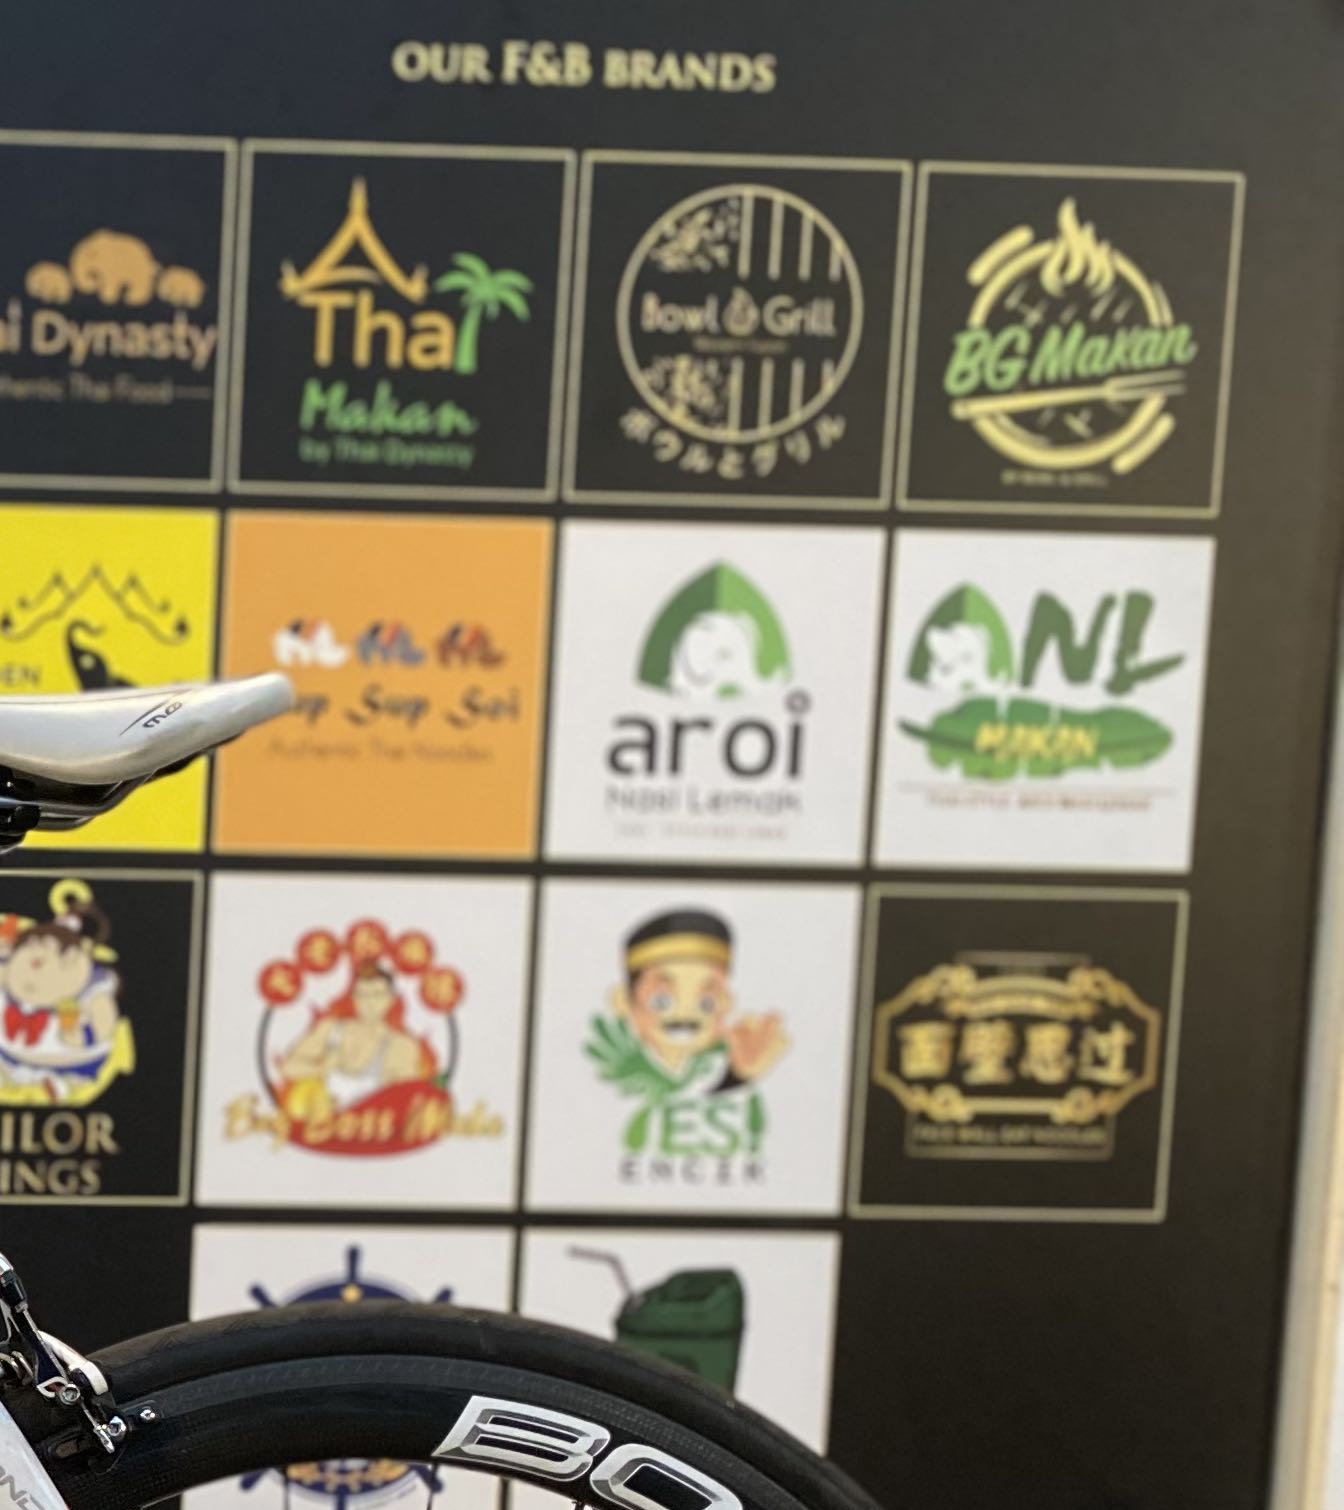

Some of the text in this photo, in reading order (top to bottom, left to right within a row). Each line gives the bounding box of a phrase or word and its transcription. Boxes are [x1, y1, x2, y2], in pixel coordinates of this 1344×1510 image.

[392, 40, 778, 94] OUR F&B BRANDS
[30, 309, 219, 372] Dynasty
[762, 294, 837, 337] Grill
[944, 320, 1199, 397] BG Makan
[299, 378, 480, 437] Makan
[606, 689, 813, 780] aroi
